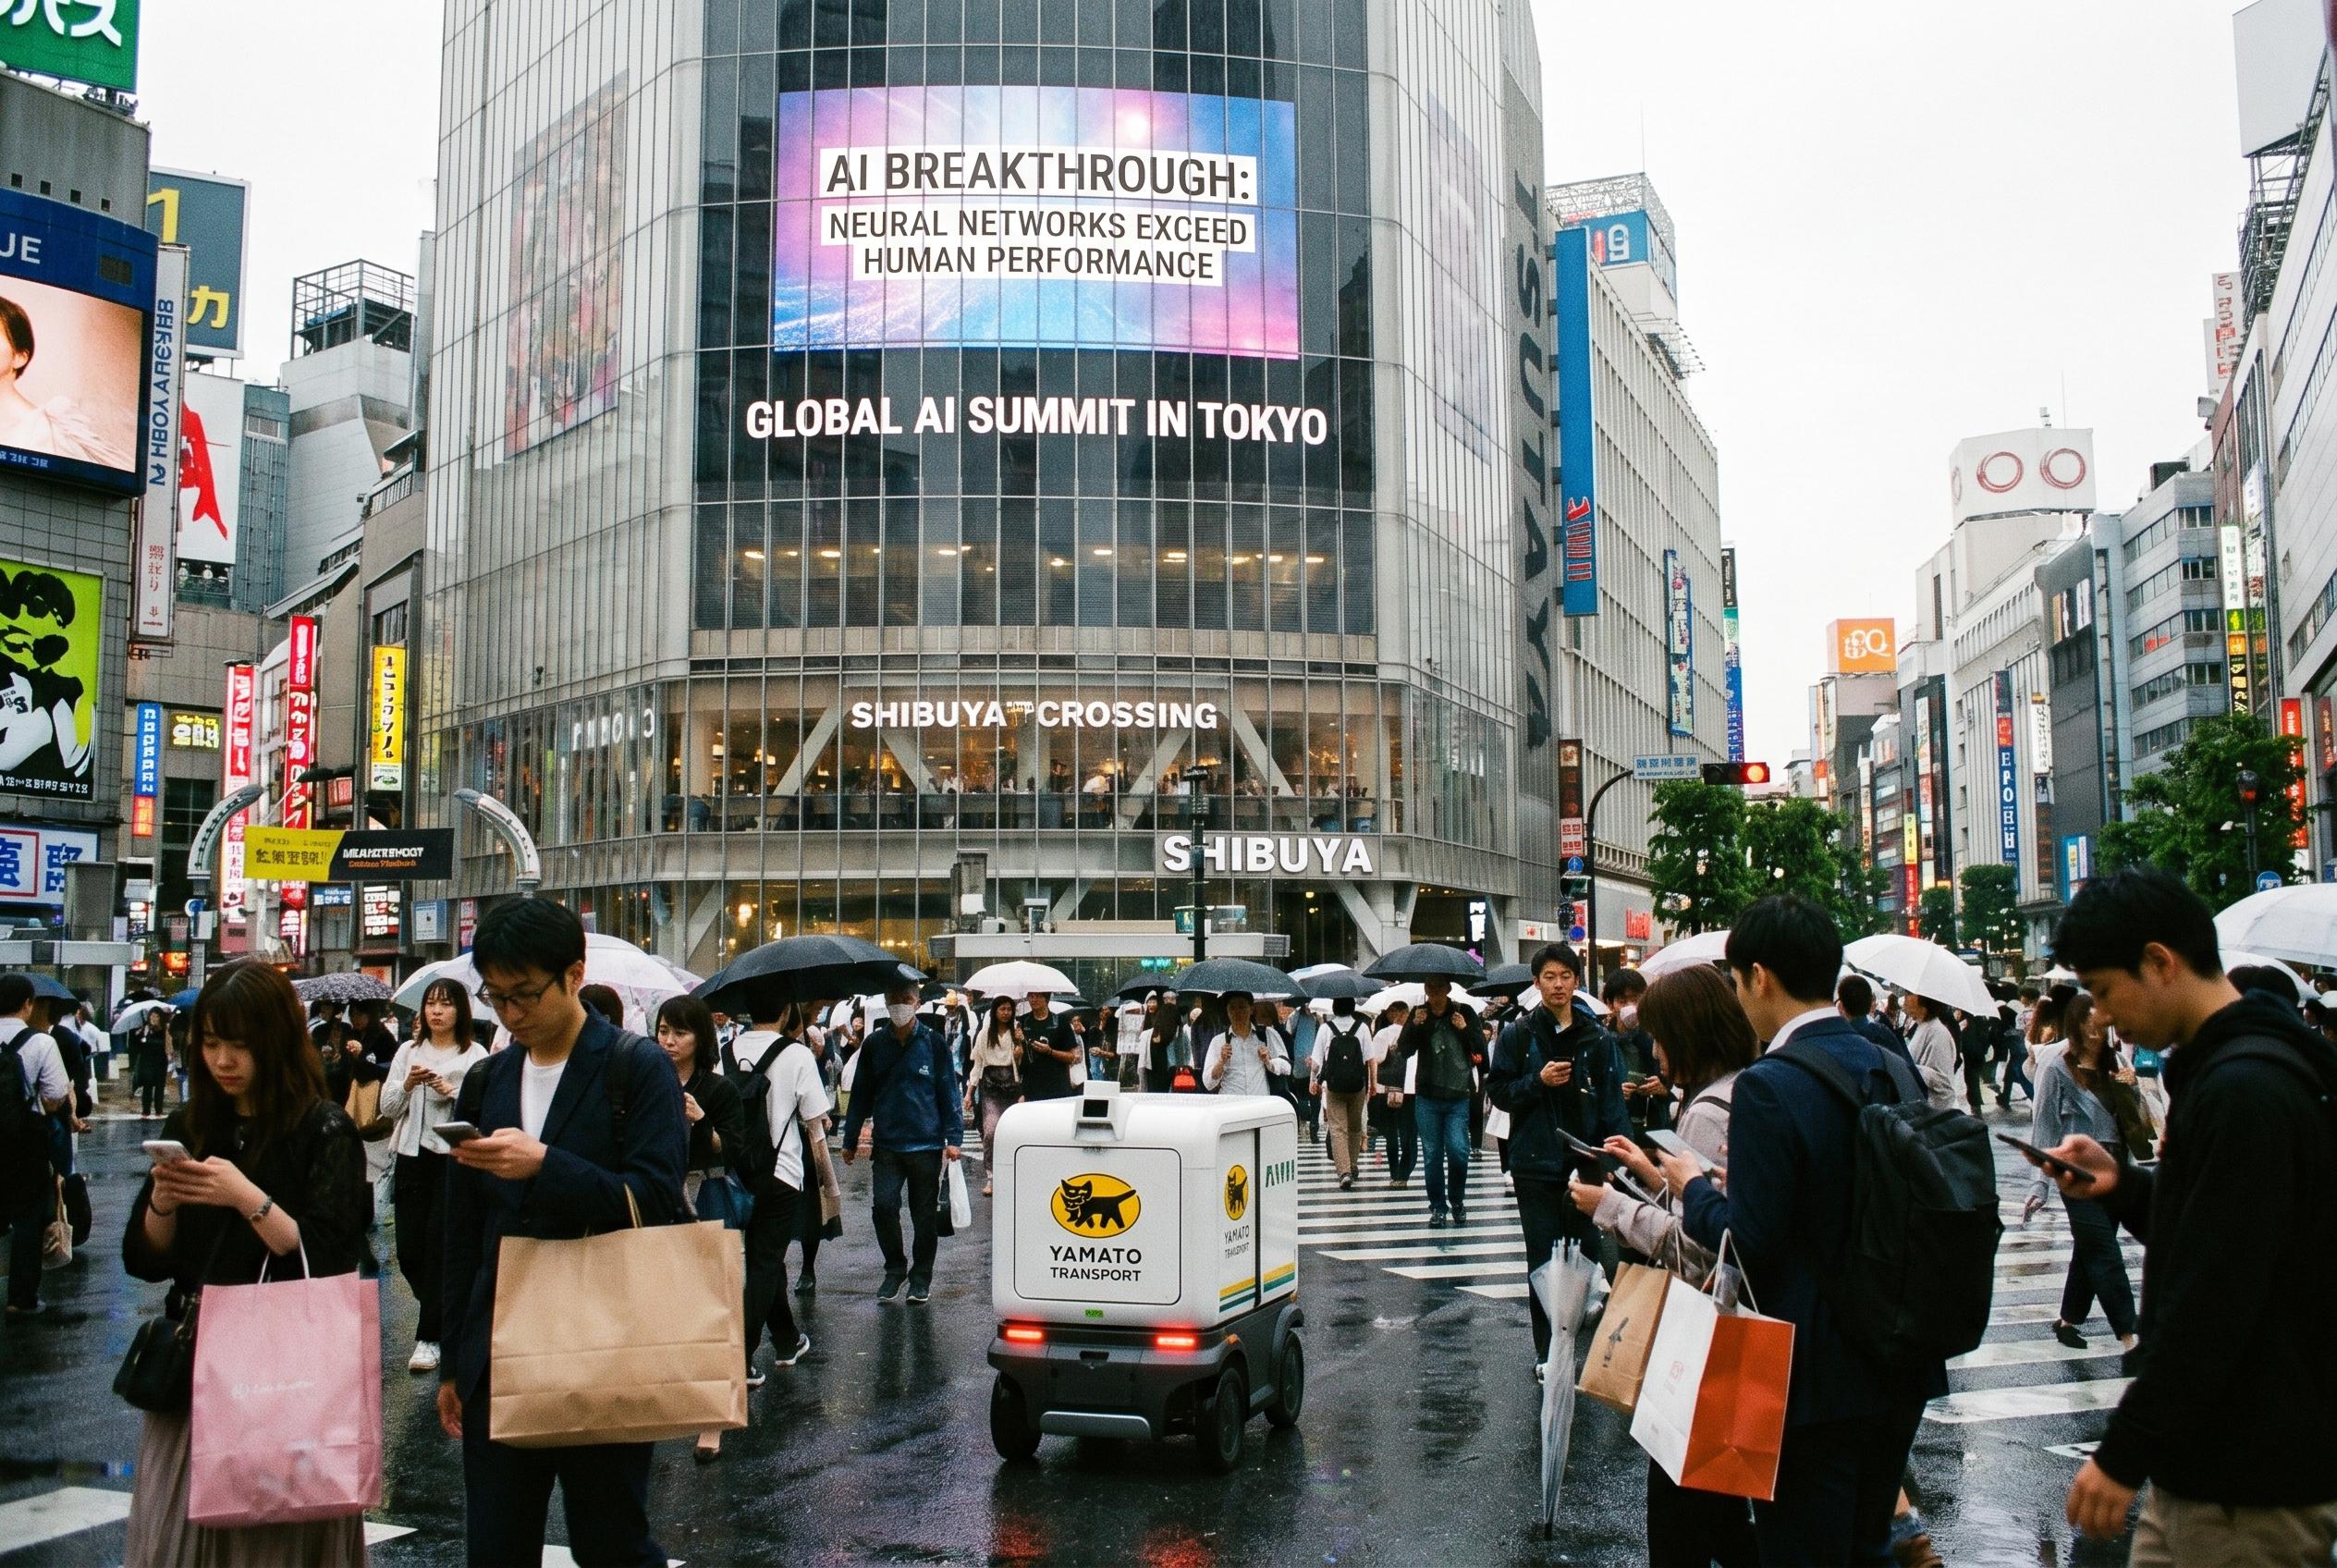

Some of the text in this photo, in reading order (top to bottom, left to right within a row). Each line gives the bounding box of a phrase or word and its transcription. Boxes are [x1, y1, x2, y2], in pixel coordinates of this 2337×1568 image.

[826, 152, 1250, 200] AI BREAKTHROUGH:
[830, 210, 1247, 245] NEURAL NETWORKS EXCEED
[863, 246, 1214, 279] HUMAN PERFORMANCE
[745, 396, 1328, 446] GLOBAL AI SUMMIT IN TOKYO
[850, 701, 1008, 729] SHIBUYA
[1037, 701, 1217, 729] CROSSING
[1163, 835, 1374, 873] SHIBUYA
[1224, 1225, 1250, 1245] YAMATO
[1049, 1244, 1143, 1265] YAMATO
[1049, 1267, 1142, 1282] TRANSPORT
